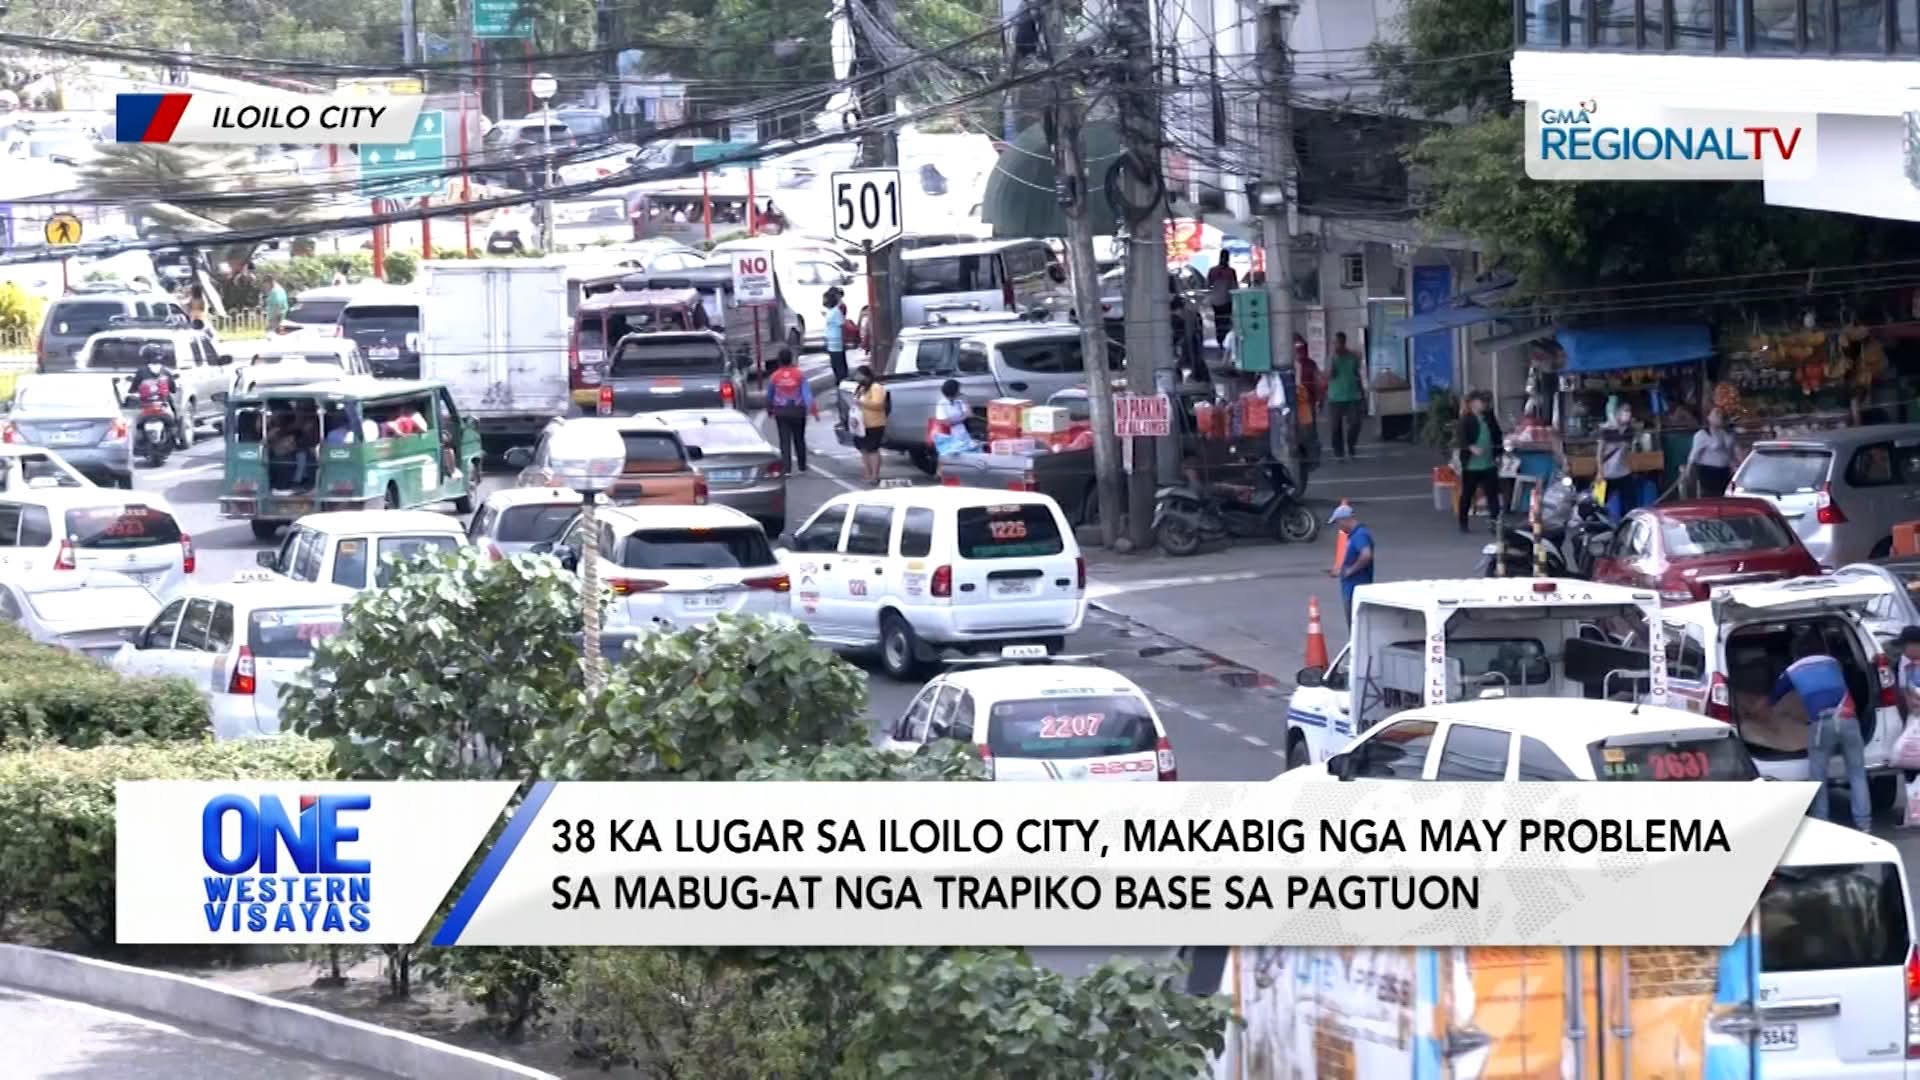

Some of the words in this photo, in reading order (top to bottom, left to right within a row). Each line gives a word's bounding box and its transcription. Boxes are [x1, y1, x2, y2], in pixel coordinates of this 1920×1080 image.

[838, 181, 898, 231] 501
[740, 256, 767, 274] NO
[1116, 398, 1129, 419] NO
[1130, 398, 1168, 419] PARKING
[1498, 592, 1593, 603] PULISYA
[1652, 632, 1666, 696] ILOILO
[1040, 713, 1104, 738] 2207
[1648, 751, 1710, 780] 2631
